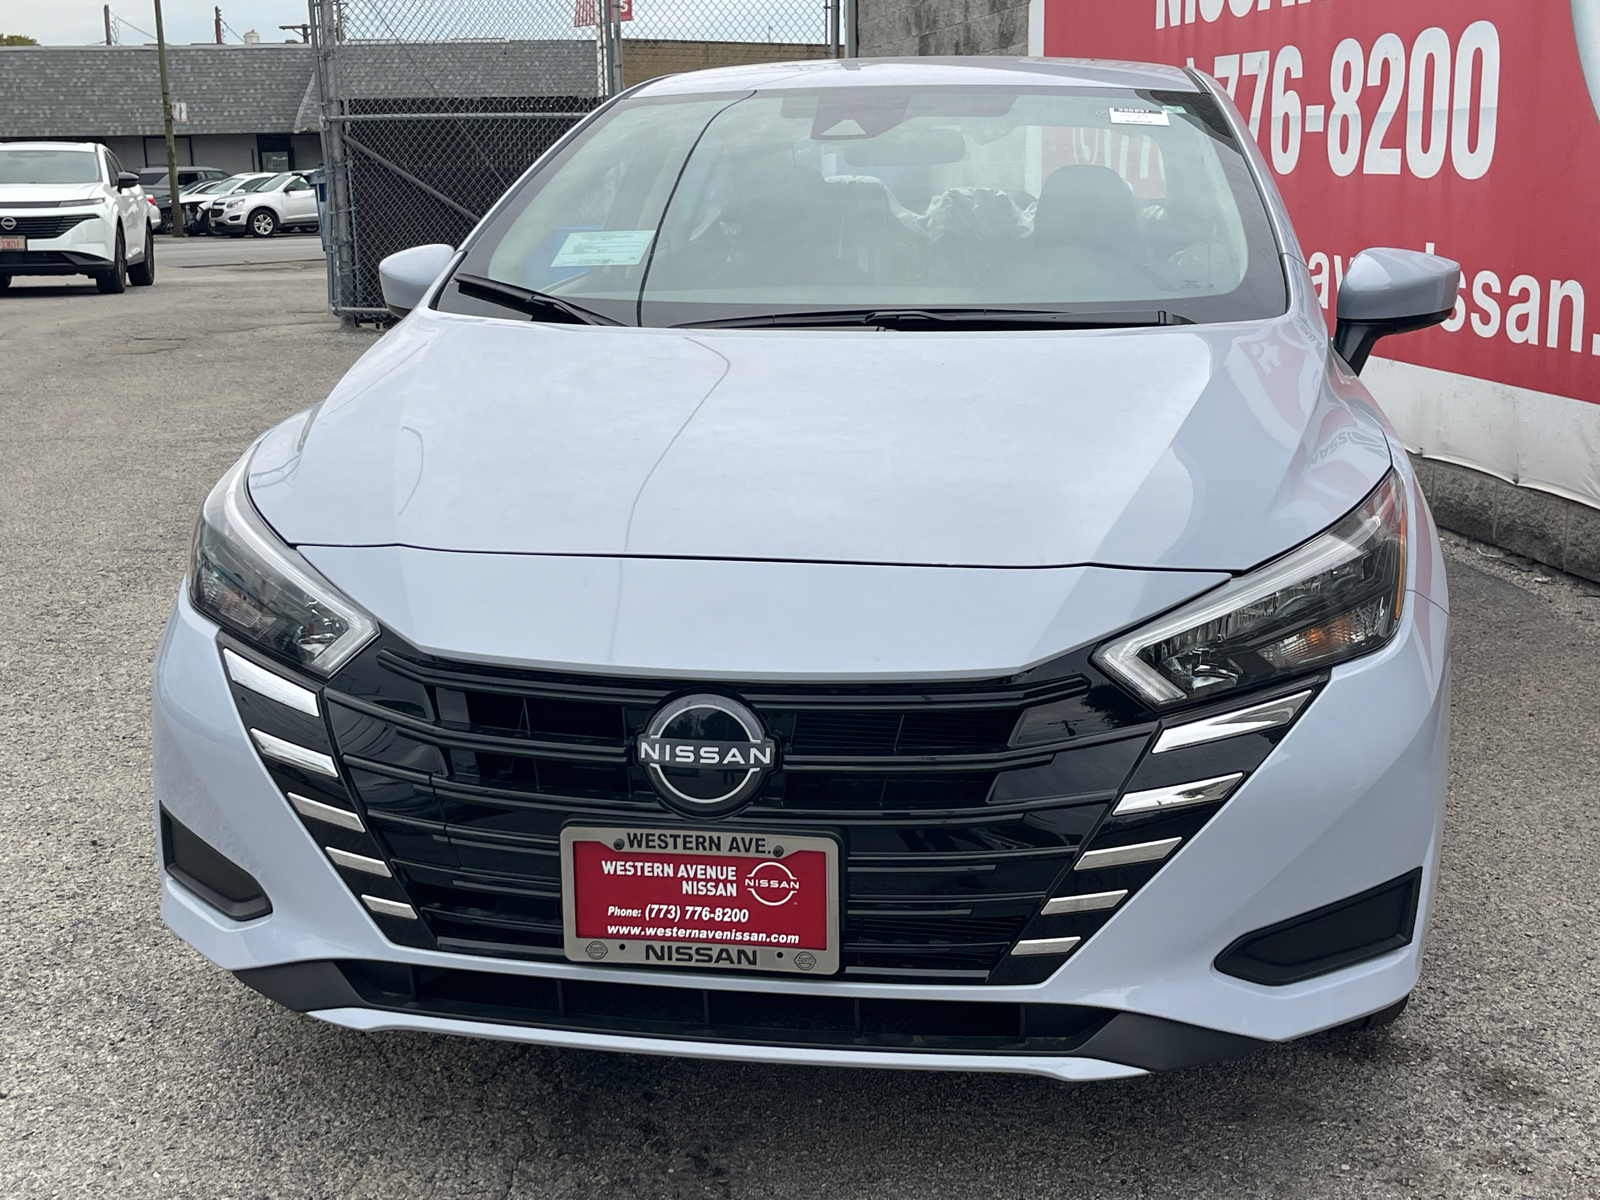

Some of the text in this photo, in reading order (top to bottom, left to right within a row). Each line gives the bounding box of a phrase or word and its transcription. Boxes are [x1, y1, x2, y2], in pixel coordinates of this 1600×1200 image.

[640, 742, 771, 765] NISSAN
[626, 832, 771, 854] WESTERN AVE.
[601, 860, 737, 880] WESTERN AVENUE
[682, 880, 737, 897] NISSAN
[744, 878, 799, 889] NISSAN
[607, 904, 749, 923] Phone: (773) 776-8200
[607, 924, 800, 944] www.westernavenissan.com
[645, 944, 757, 966] NISSAN
